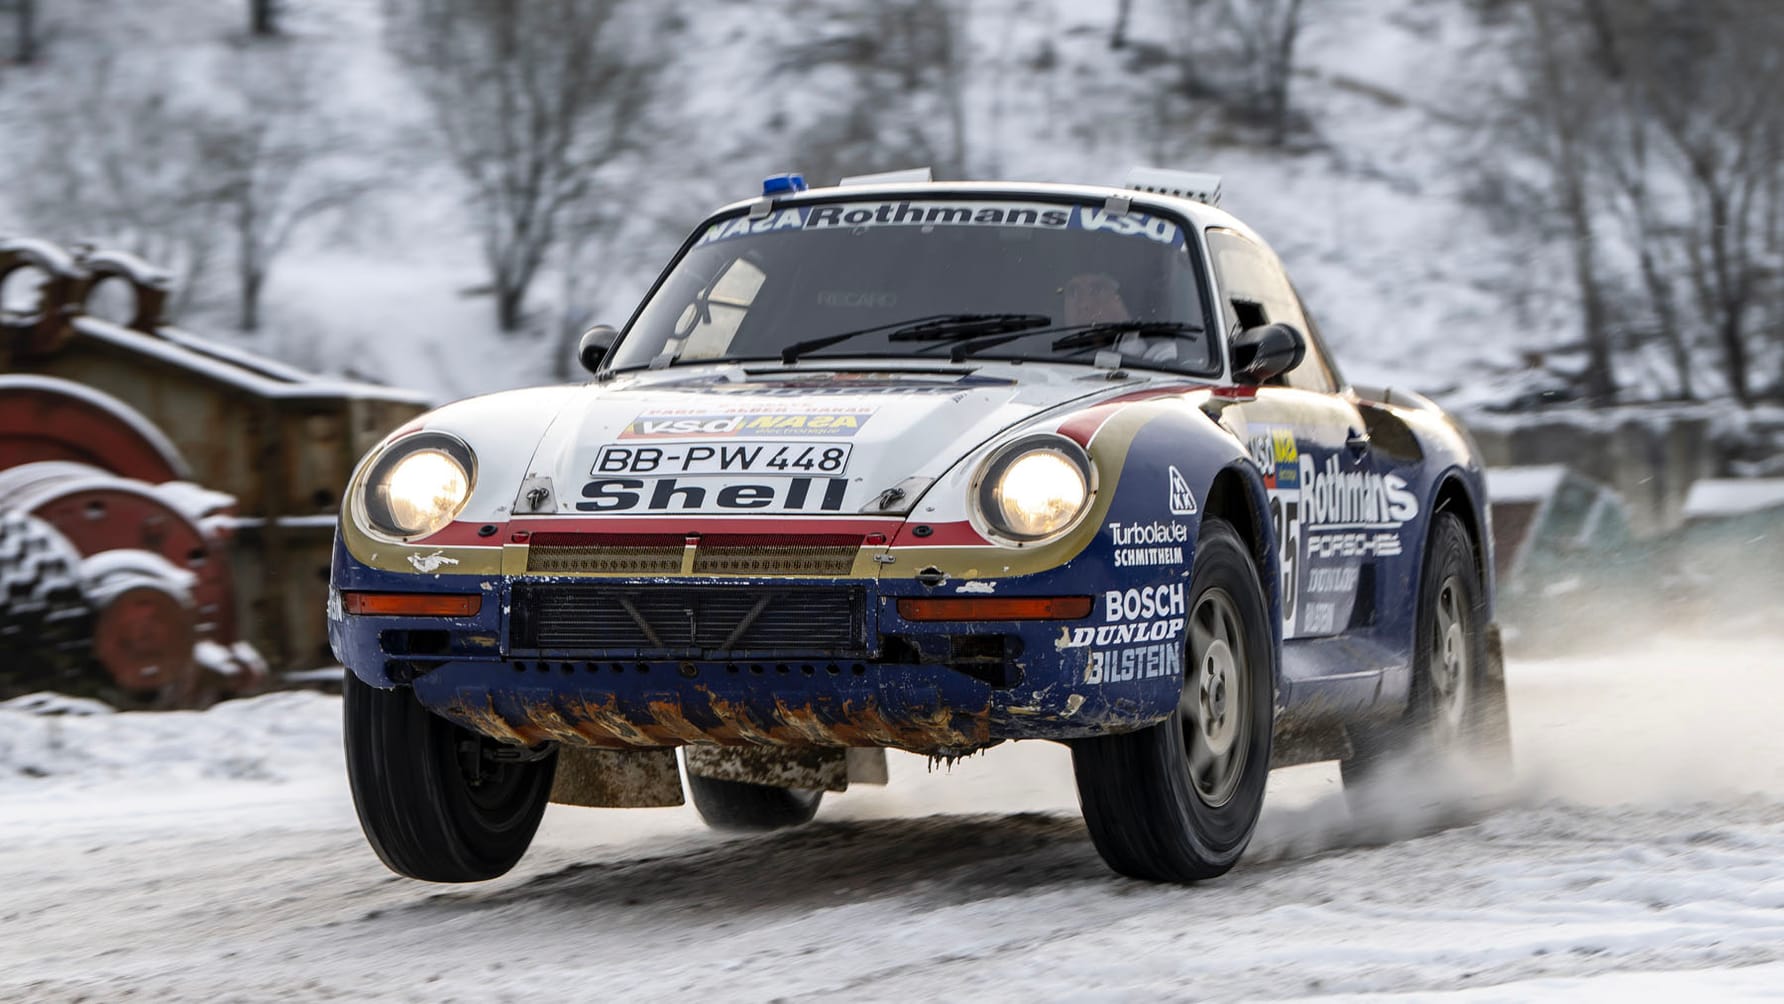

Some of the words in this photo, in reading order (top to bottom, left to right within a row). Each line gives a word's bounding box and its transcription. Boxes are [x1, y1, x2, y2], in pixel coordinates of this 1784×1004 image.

[806, 201, 1070, 228] Rothmans
[600, 445, 763, 473] BB-PW
[767, 444, 846, 471] 448
[575, 478, 849, 512] Shell
[1300, 453, 1419, 525] Rothmans
[1109, 520, 1188, 545] Turbolader
[1307, 533, 1403, 560] PORSCHE
[1114, 547, 1183, 567] SCHMITTHELM
[1106, 583, 1185, 622] BOSCH
[1069, 618, 1185, 648] DUNLOP
[1086, 641, 1181, 685] BILSTEIN
